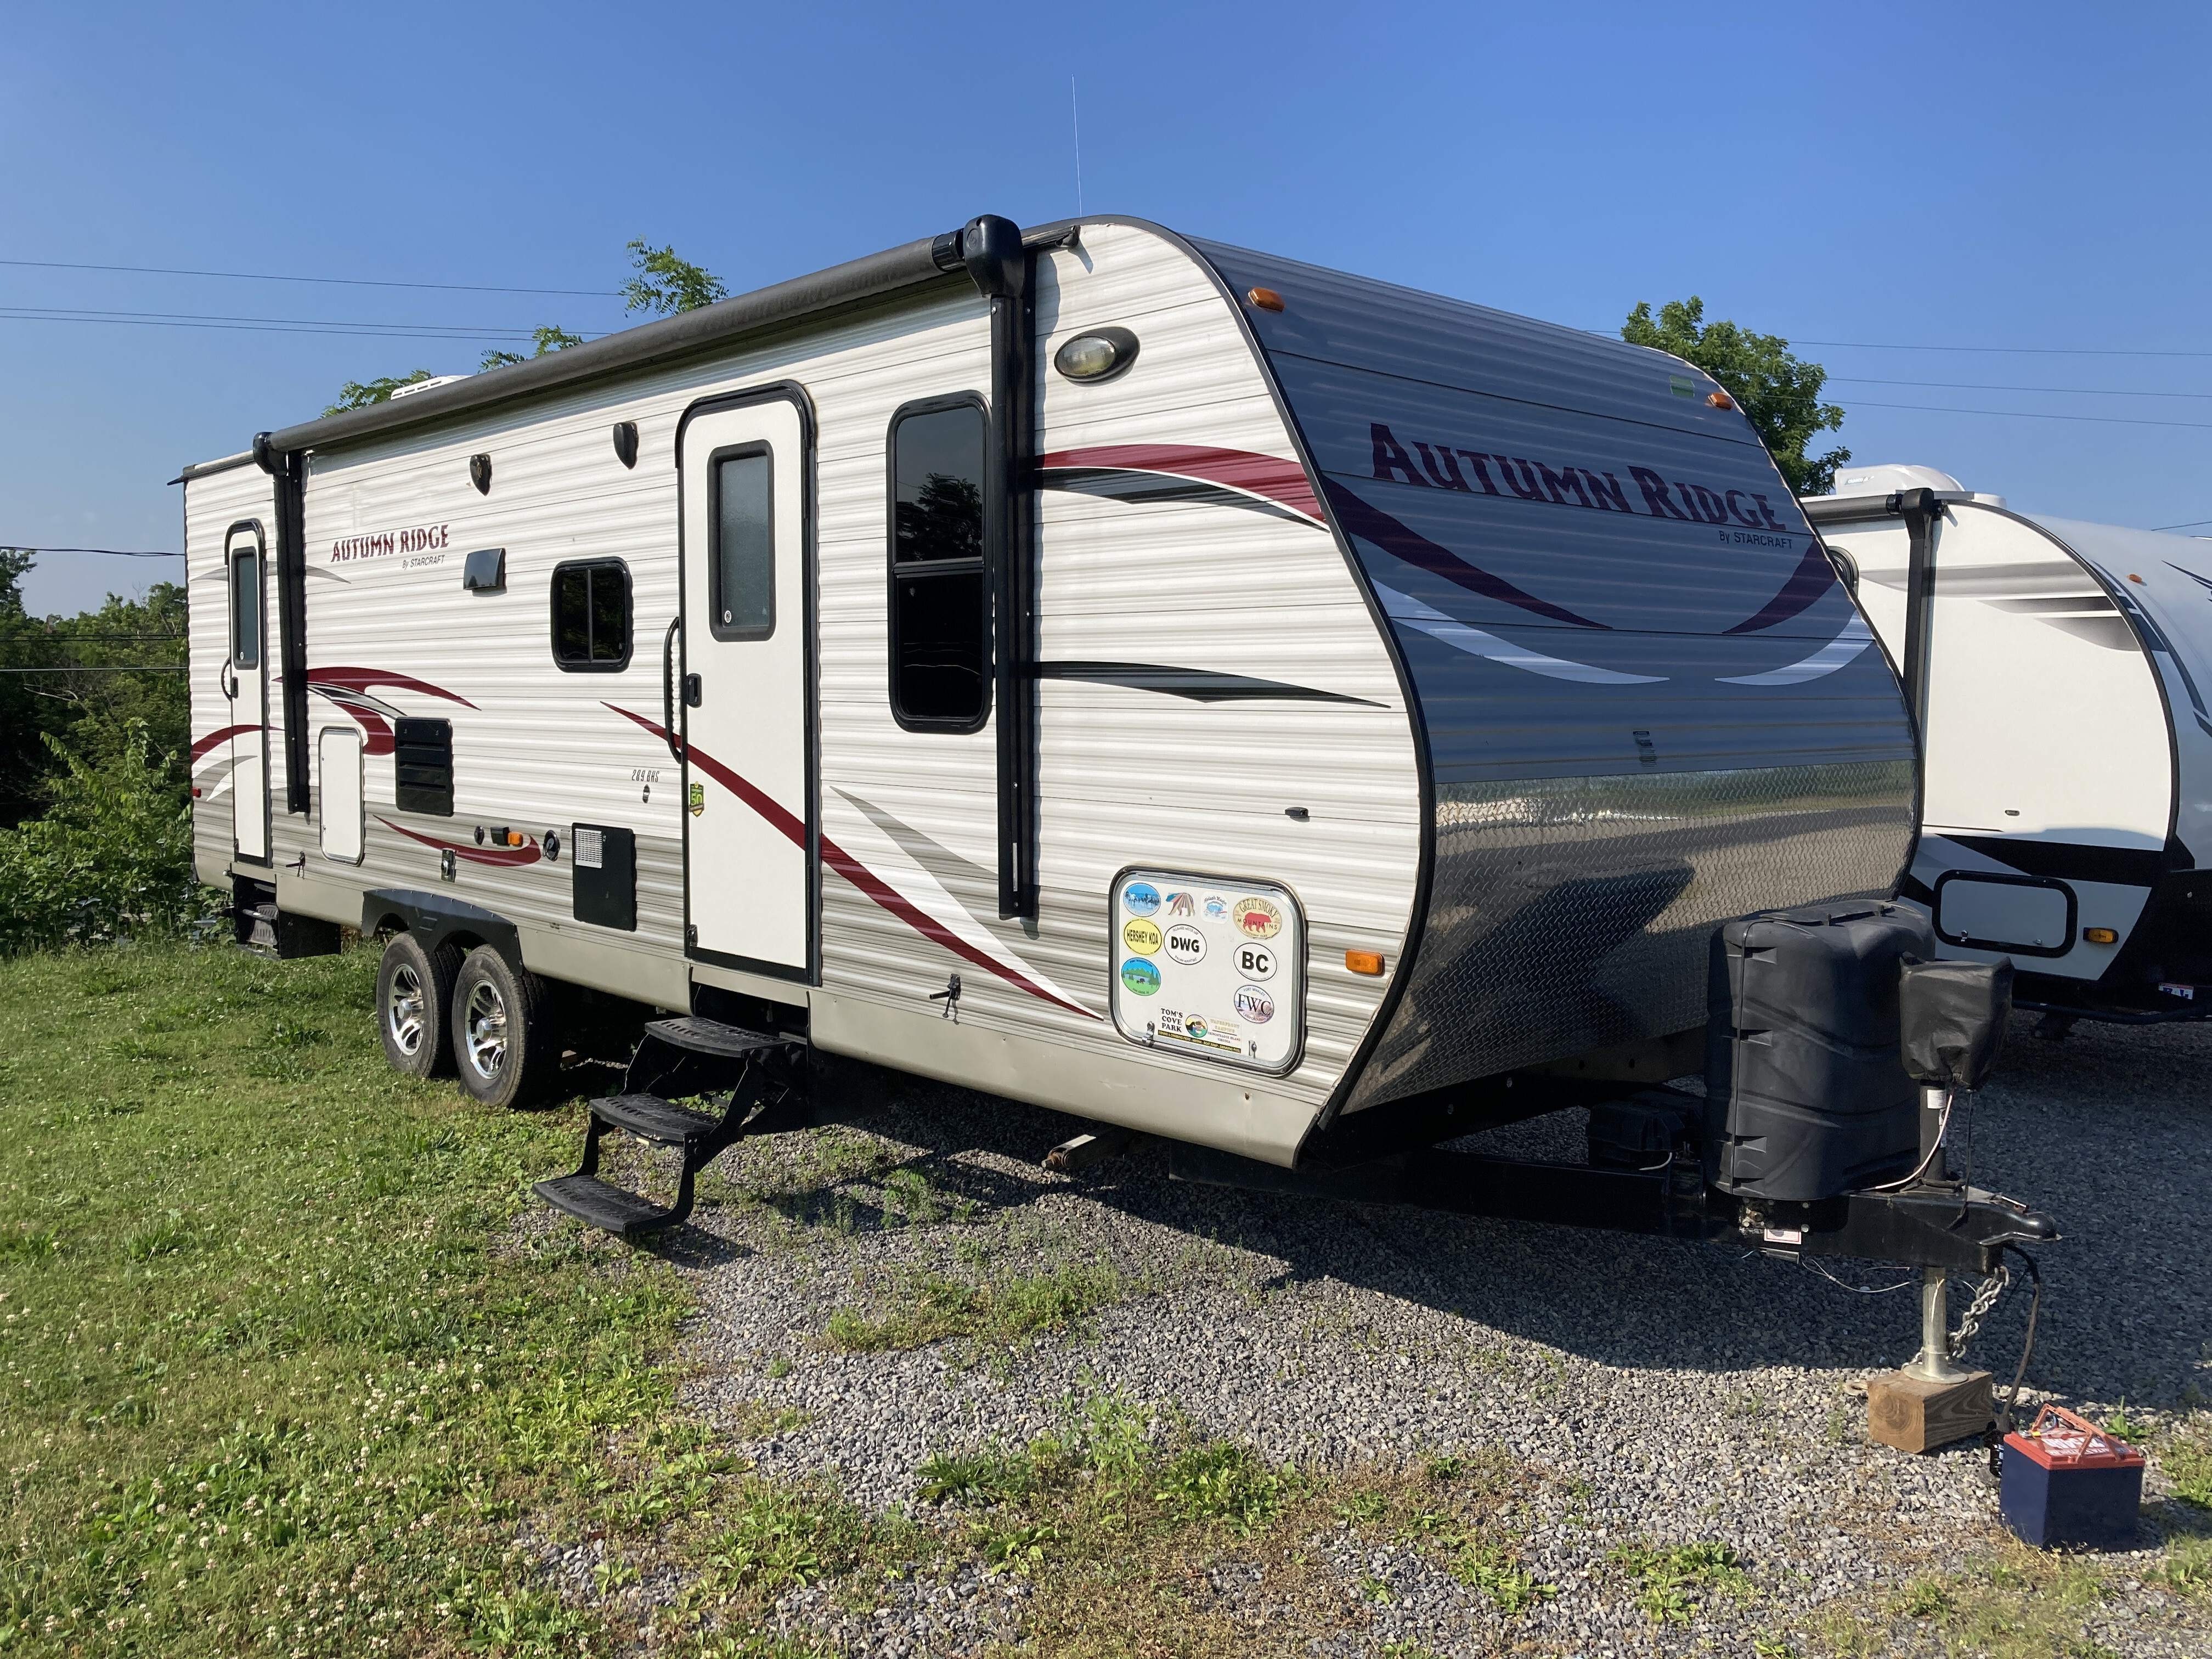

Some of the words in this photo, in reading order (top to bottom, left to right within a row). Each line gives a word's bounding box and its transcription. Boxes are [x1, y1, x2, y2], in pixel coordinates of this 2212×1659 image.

[1370, 423, 1634, 513] AUTUMN
[1626, 465, 1787, 532] RIDGE
[330, 532, 395, 563] AUTUMN
[399, 524, 450, 554] RIDGE
[1718, 530, 1730, 545] By
[1734, 532, 1792, 549] STARCRAFT
[402, 560, 409, 571] By
[410, 555, 445, 568] STARCRAFT
[631, 769, 646, 782] 289
[646, 770, 660, 783] BHS
[690, 792, 703, 805] 50
[1239, 898, 1257, 913] GREAT
[1259, 899, 1279, 919] SMOKY
[1237, 917, 1278, 930] MOUNTAINS
[1126, 929, 1148, 944] HERSHEY
[1149, 932, 1159, 945] KOA
[1171, 935, 1200, 953] DWG
[1242, 950, 1269, 973] BC
[1237, 993, 1271, 1016] FWC
[1160, 1008, 1183, 1018] TOM'S
[1161, 1015, 1182, 1026] COVE
[1161, 1022, 1182, 1033] PARK
